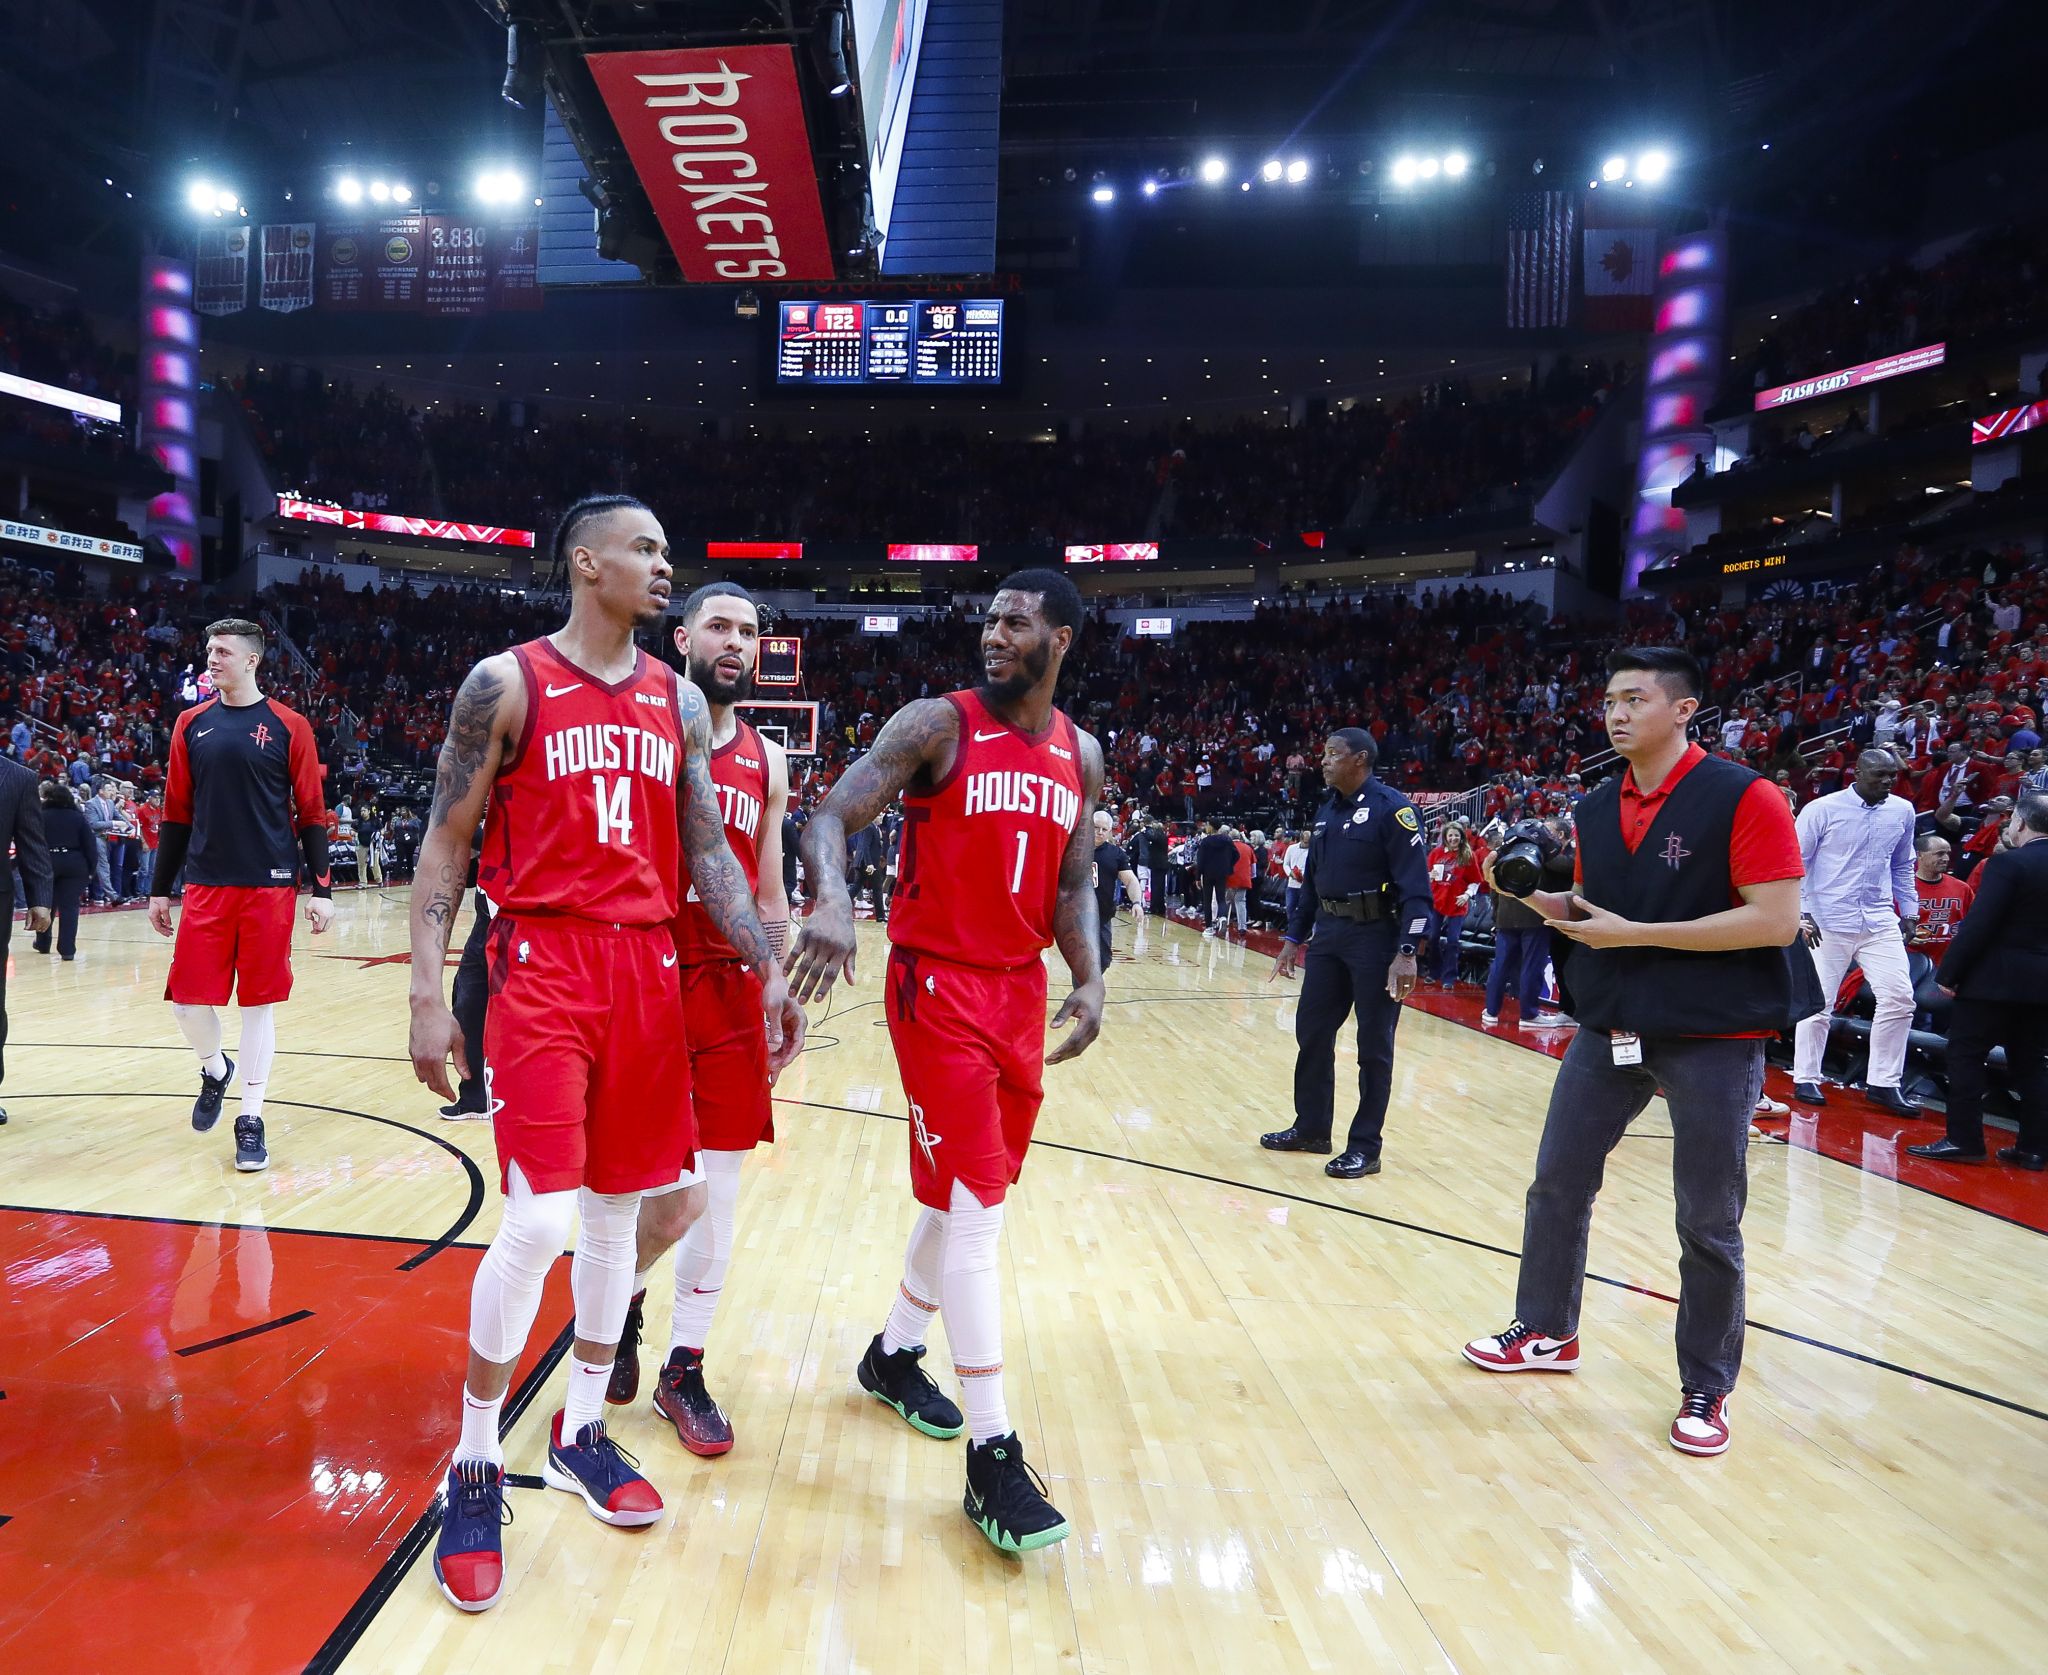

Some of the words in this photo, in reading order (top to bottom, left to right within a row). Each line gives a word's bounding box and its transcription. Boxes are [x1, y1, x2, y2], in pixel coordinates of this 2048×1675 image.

[634, 58, 787, 278] ROCKETS
[432, 227, 486, 251] 3,830
[824, 314, 854, 330] 122
[885, 310, 908, 323] 0.0
[926, 306, 957, 314] JAZZ
[932, 314, 954, 330] 90
[1773, 383, 1814, 403] FLASH
[1816, 370, 1857, 394] SEATS
[1723, 559, 1760, 574] ROCKETS
[1764, 555, 1786, 568] WIN!
[770, 641, 788, 653] 0.0
[545, 724, 674, 787] HOUSTON
[592, 775, 632, 845] 14
[965, 771, 1079, 835] HOUSTON
[1012, 830, 1028, 894] 1
